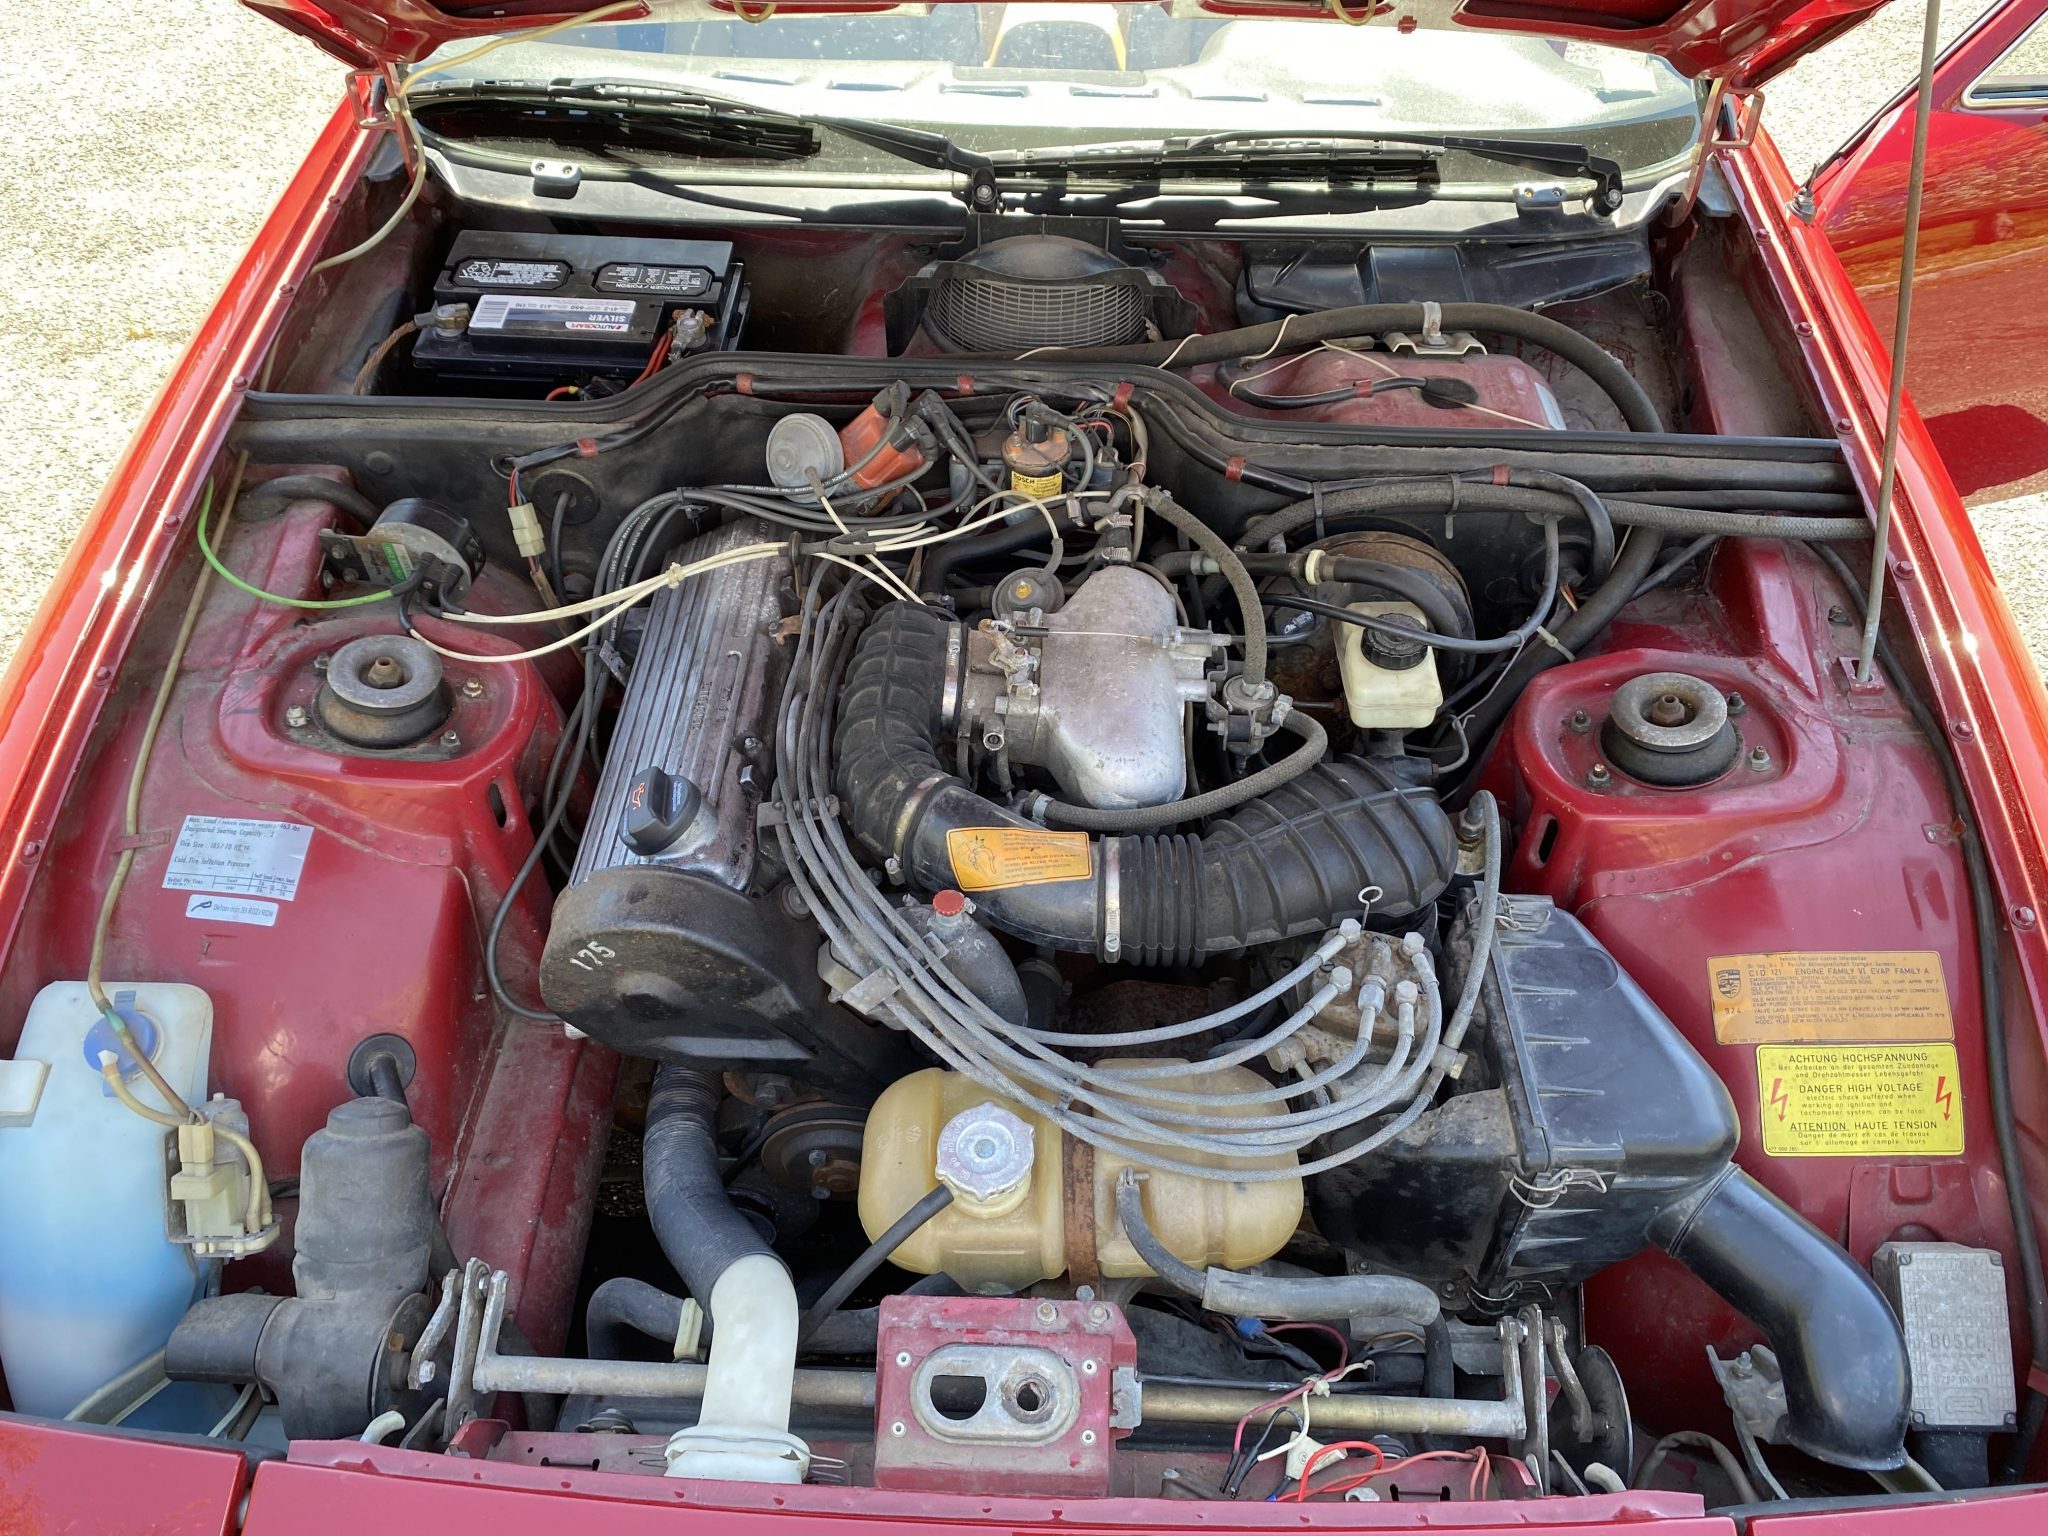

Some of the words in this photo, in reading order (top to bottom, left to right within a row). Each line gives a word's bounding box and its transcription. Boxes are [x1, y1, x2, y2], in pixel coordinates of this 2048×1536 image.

[1014, 473, 1035, 484] BOSCH
[185, 825, 215, 833] Designated
[217, 828, 237, 836] Seating
[201, 858, 225, 866] Inflation
[570, 941, 615, 971] 175
[1789, 1054, 1838, 1062] ACHTUNG
[1842, 1052, 1928, 1062] HOCHSPANNUNG
[1800, 1084, 1842, 1094] DANGER
[1848, 1084, 1872, 1092] HIGH
[1877, 1083, 1924, 1092] VOLTAGE
[1790, 1122, 1846, 1131] ATTENTION
[1854, 1122, 1888, 1130] HAUTE
[1894, 1120, 1938, 1130] TENSION
[1931, 1333, 1986, 1348] BOSCH
